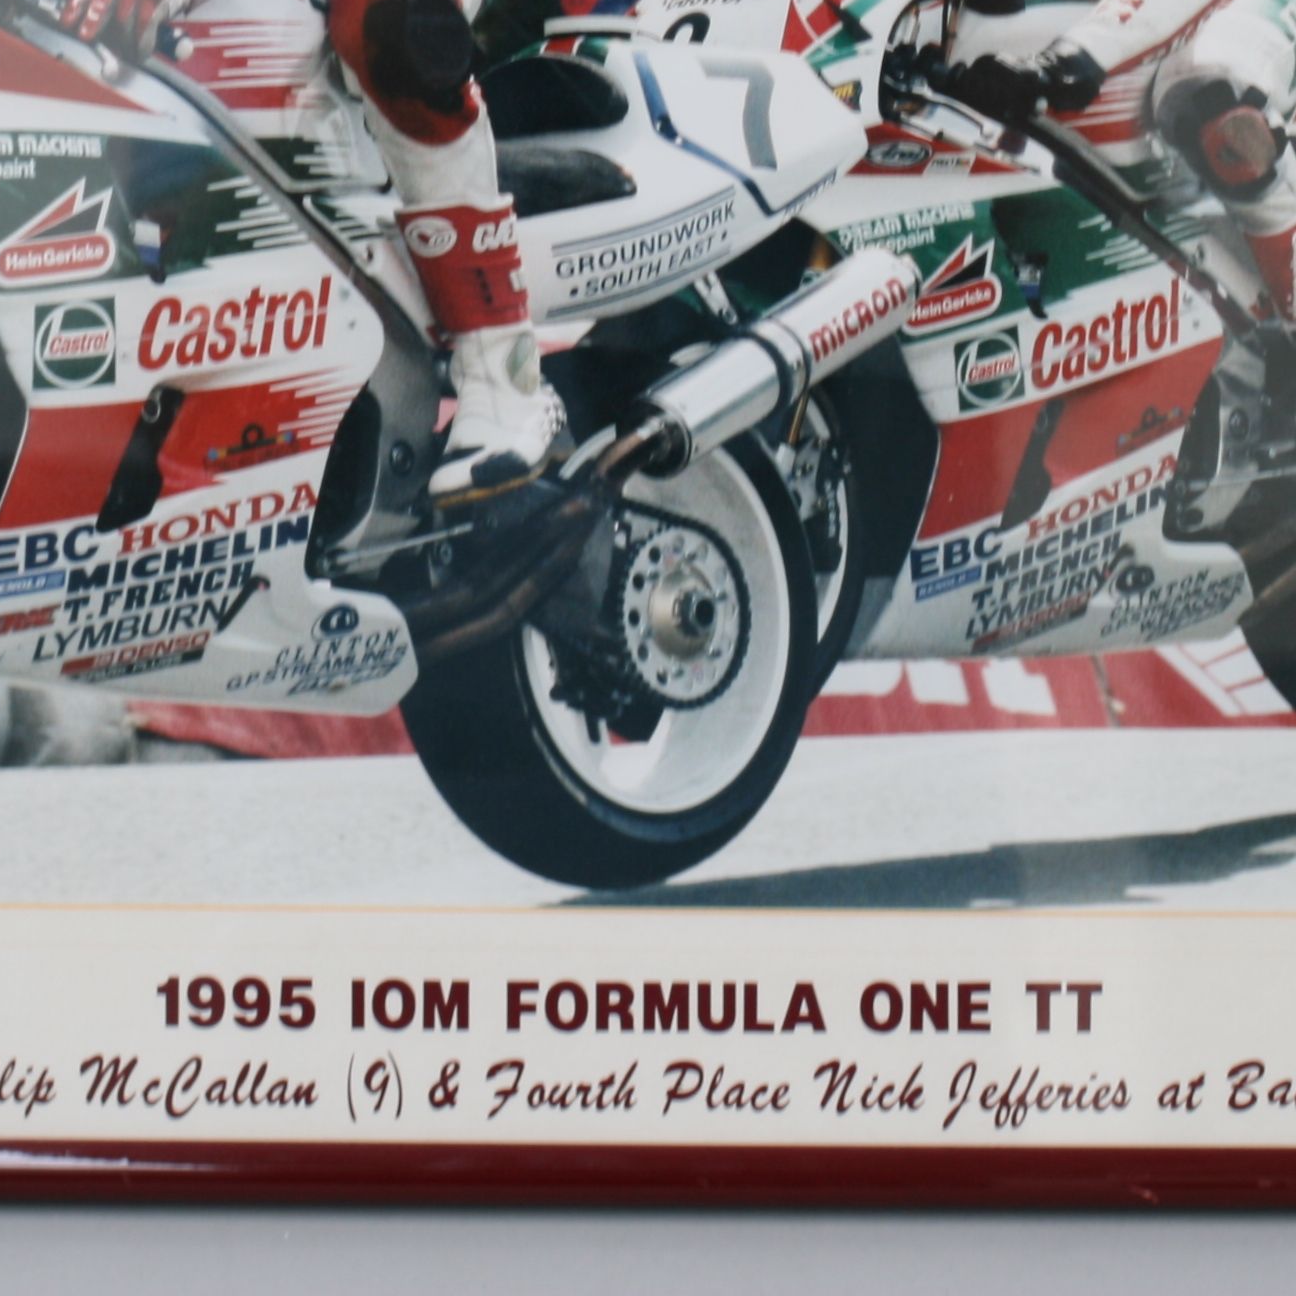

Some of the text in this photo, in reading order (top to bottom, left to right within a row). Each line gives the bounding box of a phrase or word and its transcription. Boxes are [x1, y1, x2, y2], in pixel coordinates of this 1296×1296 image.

[699, 57, 779, 171] 7
[555, 200, 736, 280] GROUNDWORK
[49, 330, 109, 355] Castrol
[138, 275, 332, 372] Castrol
[1031, 278, 1181, 391] Castrol
[968, 356, 1016, 383] Castrol
[116, 481, 319, 556] HONDA
[1027, 453, 1178, 542] HONDA
[67, 516, 310, 595] MICHELIN
[910, 526, 1003, 581] EBC
[157, 975, 1103, 1034] 1995 IOM FORMULA ONE TT
[79, 1054, 318, 1118] McCallan
[427, 1060, 460, 1107] &
[485, 1059, 639, 1119] Fourth
[661, 1060, 791, 1116] Place
[812, 1060, 925, 1112] Nick
[942, 1060, 1131, 1129] Jefferies
[1158, 1072, 1206, 1110] at
